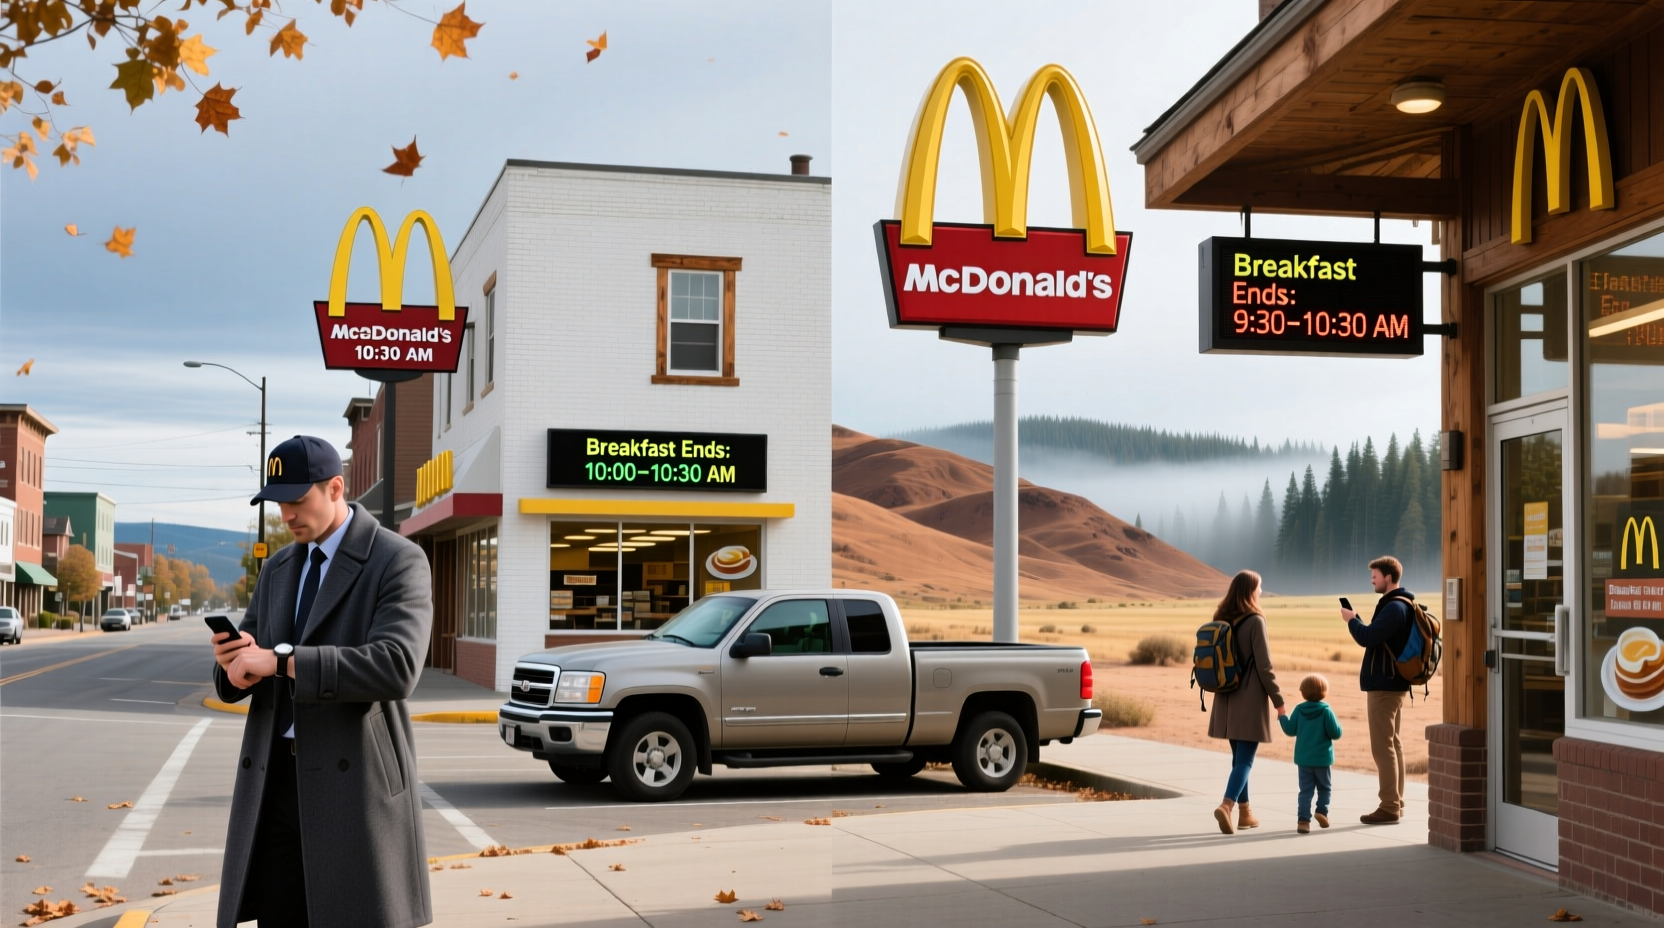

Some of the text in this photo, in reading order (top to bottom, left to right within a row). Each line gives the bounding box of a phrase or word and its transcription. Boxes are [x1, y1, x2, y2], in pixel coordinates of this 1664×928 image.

[1234, 253, 1357, 281] Breakfast
[903, 263, 1113, 299] McDonald's
[1233, 281, 1296, 306] Ends:
[1372, 314, 1409, 339] AM
[354, 345, 433, 362] 10:30 AM
[586, 438, 731, 459] Breakfast Ends:
[706, 465, 736, 483] AM
